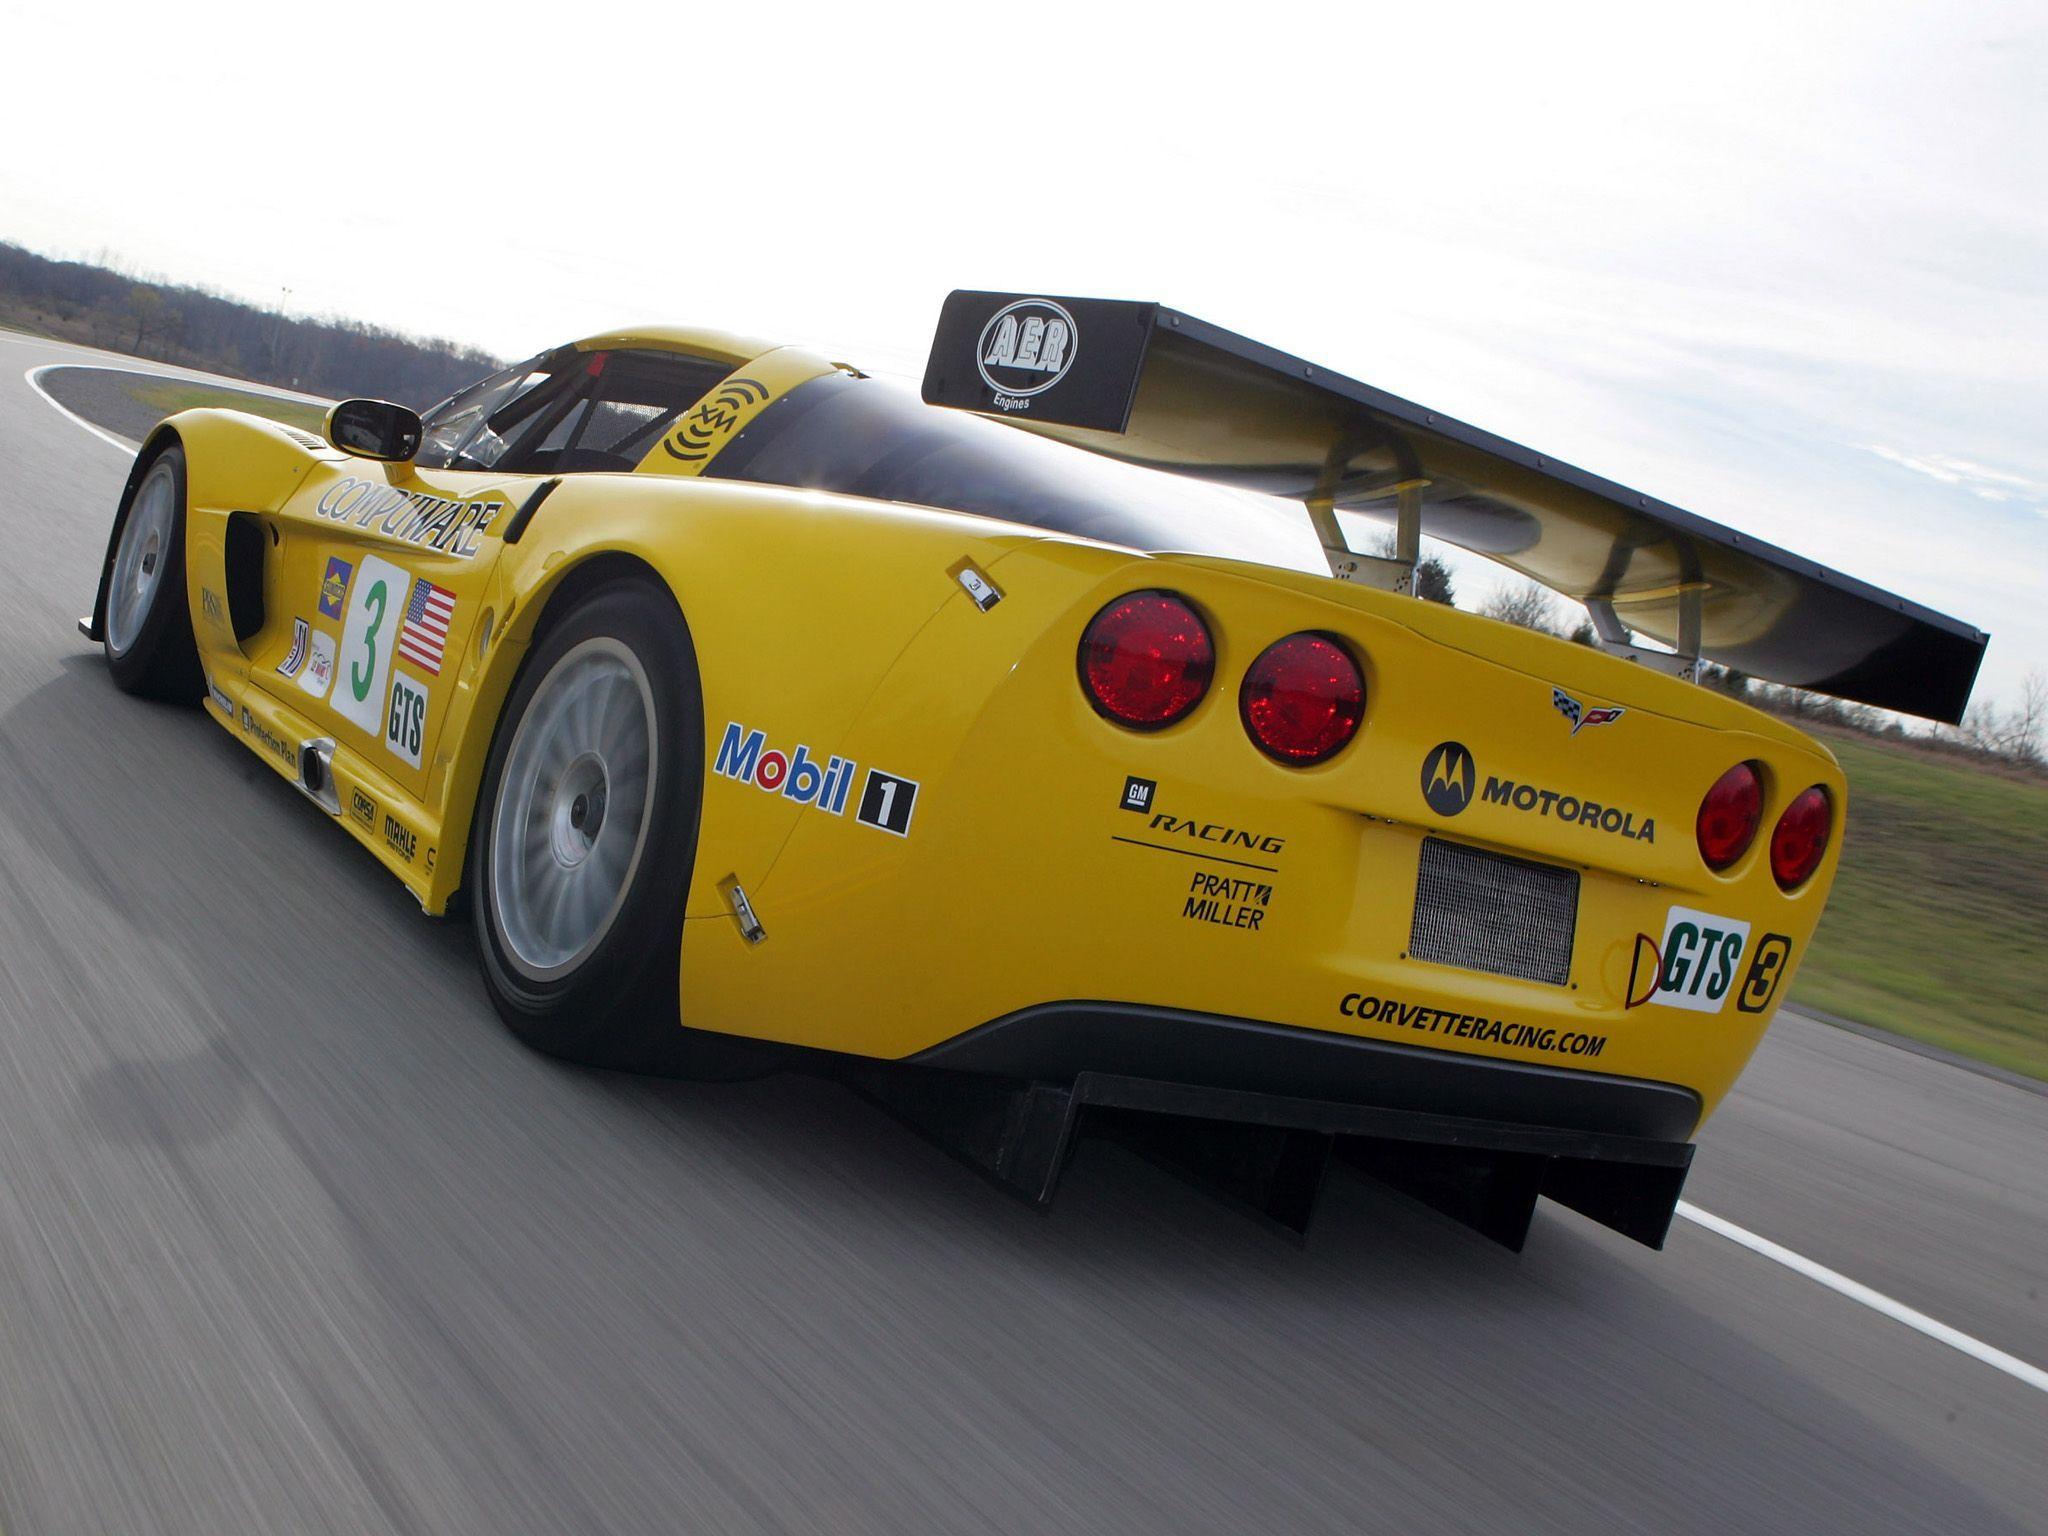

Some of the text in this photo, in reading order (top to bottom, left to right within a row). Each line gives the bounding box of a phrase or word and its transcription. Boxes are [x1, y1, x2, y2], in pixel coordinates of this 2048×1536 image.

[984, 314, 1068, 373] AER
[690, 404, 738, 433] XM
[993, 392, 1030, 411] Engines
[316, 476, 504, 560] COMPUWARE
[351, 579, 387, 702] 3
[388, 681, 425, 756] GTS
[713, 720, 898, 826] Mobil 1
[1129, 783, 1149, 802] GM
[384, 814, 417, 858] MAHLE
[1149, 814, 1286, 854] RACING
[1481, 776, 1655, 845] MOTOROLA
[1183, 896, 1265, 930] MILLER
[1190, 871, 1256, 902] PRATT
[1659, 921, 1743, 1000] GTS
[1738, 933, 1791, 1012] 3
[1339, 993, 1607, 1056] CORVETTERACING.COM
